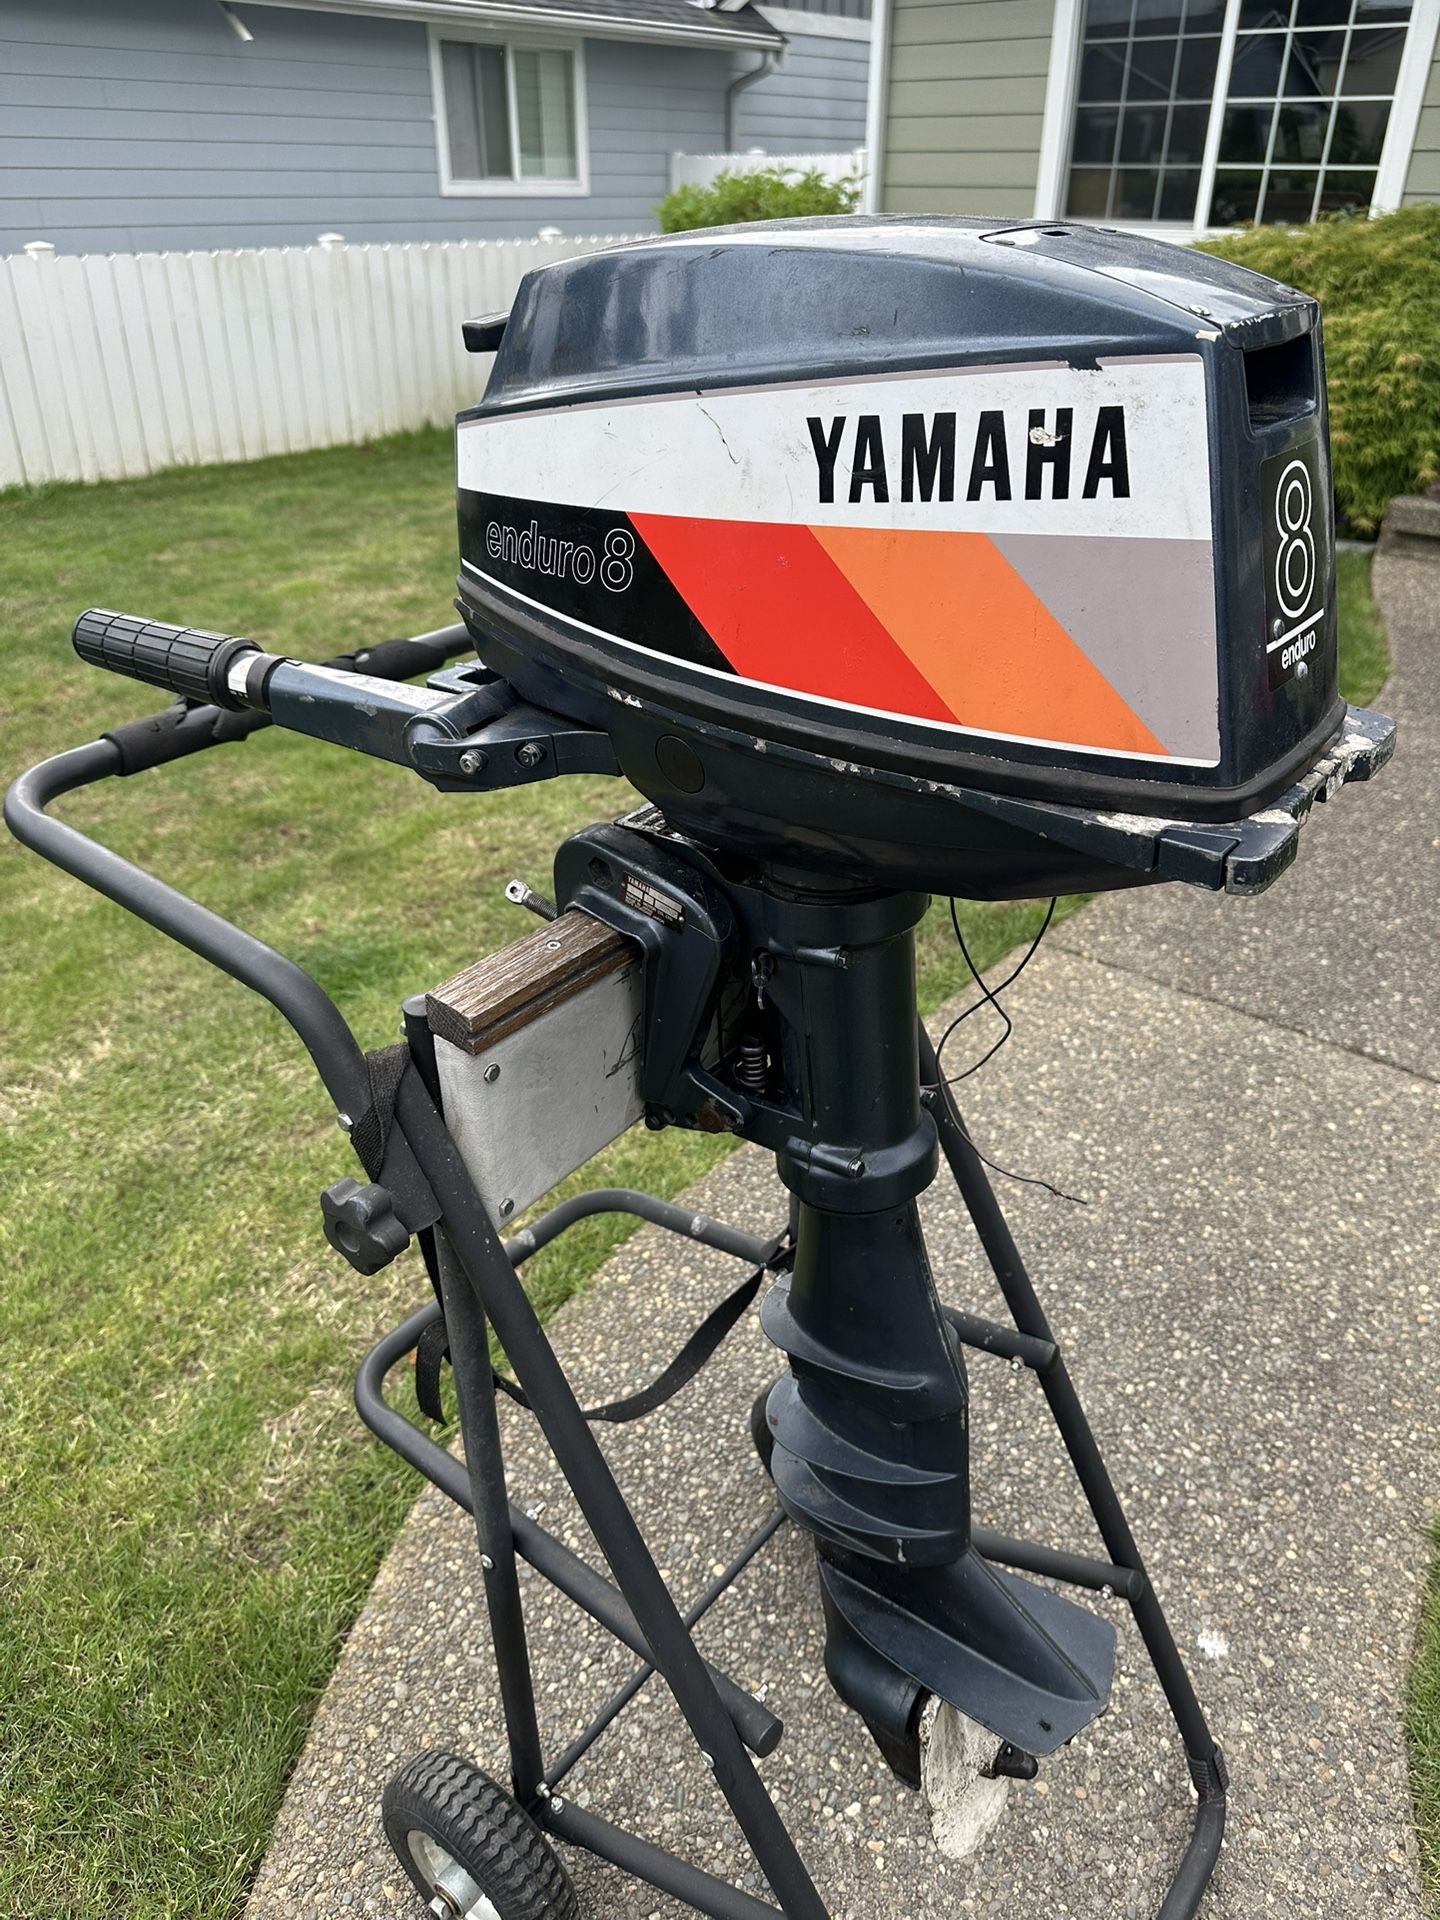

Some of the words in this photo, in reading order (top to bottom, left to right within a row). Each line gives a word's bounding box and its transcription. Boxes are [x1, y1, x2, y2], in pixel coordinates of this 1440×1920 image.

[806, 405, 1131, 503] YAMAHA
[486, 520, 596, 585] enduro
[600, 528, 635, 593] 8
[1276, 459, 1316, 618] 8
[1281, 630, 1316, 670] enduro
